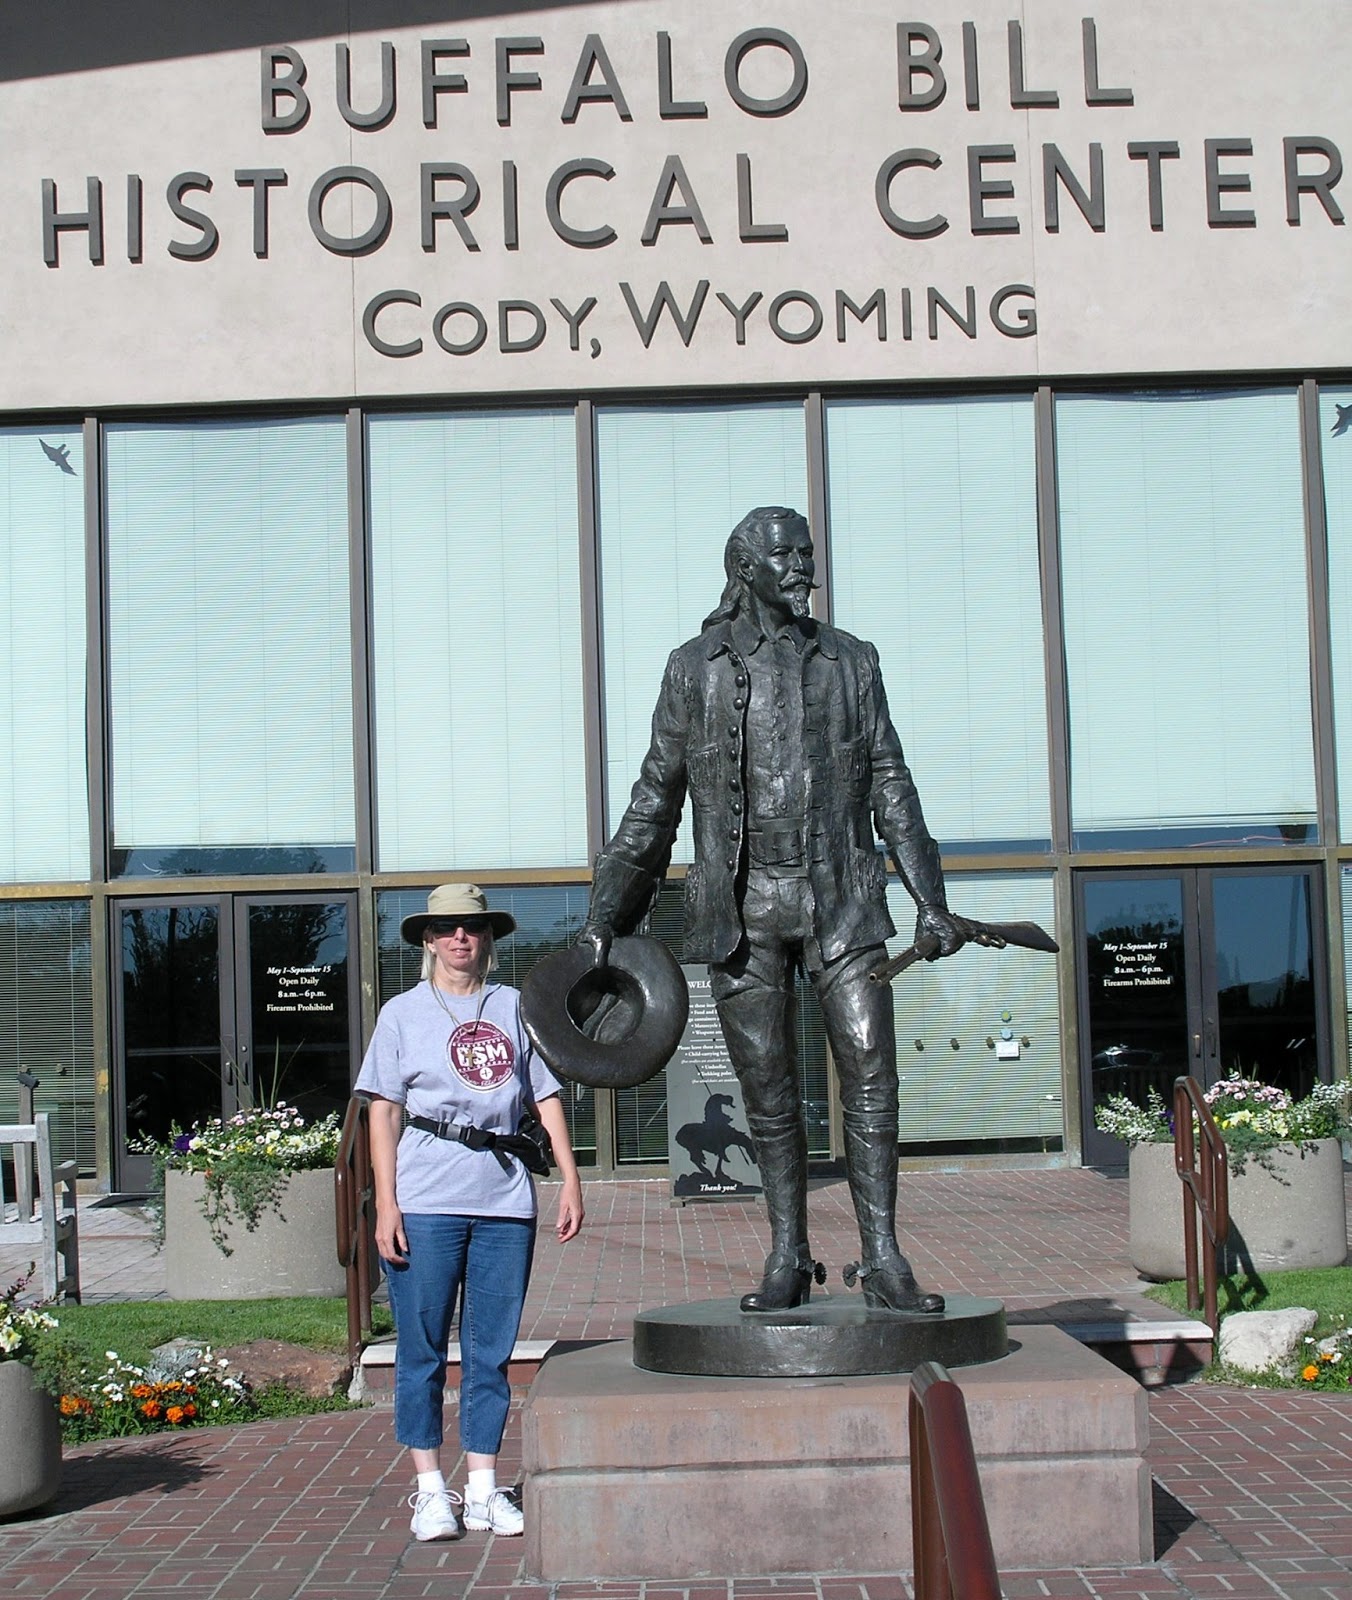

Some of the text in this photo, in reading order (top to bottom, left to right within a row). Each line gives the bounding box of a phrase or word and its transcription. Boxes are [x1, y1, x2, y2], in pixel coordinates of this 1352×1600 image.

[261, 17, 1134, 135] BUFFALO BILL
[42, 136, 1345, 268] HISTORICAL CENTER
[1103, 943, 1118, 952] May
[1115, 953, 1157, 964] Open Daily
[267, 966, 282, 976] May
[279, 976, 320, 987] Open Daily
[1103, 977, 1171, 987] Firearms Prohibited
[267, 1003, 334, 1012] Firearms Prohibited
[700, 1183, 721, 1191] Thank
